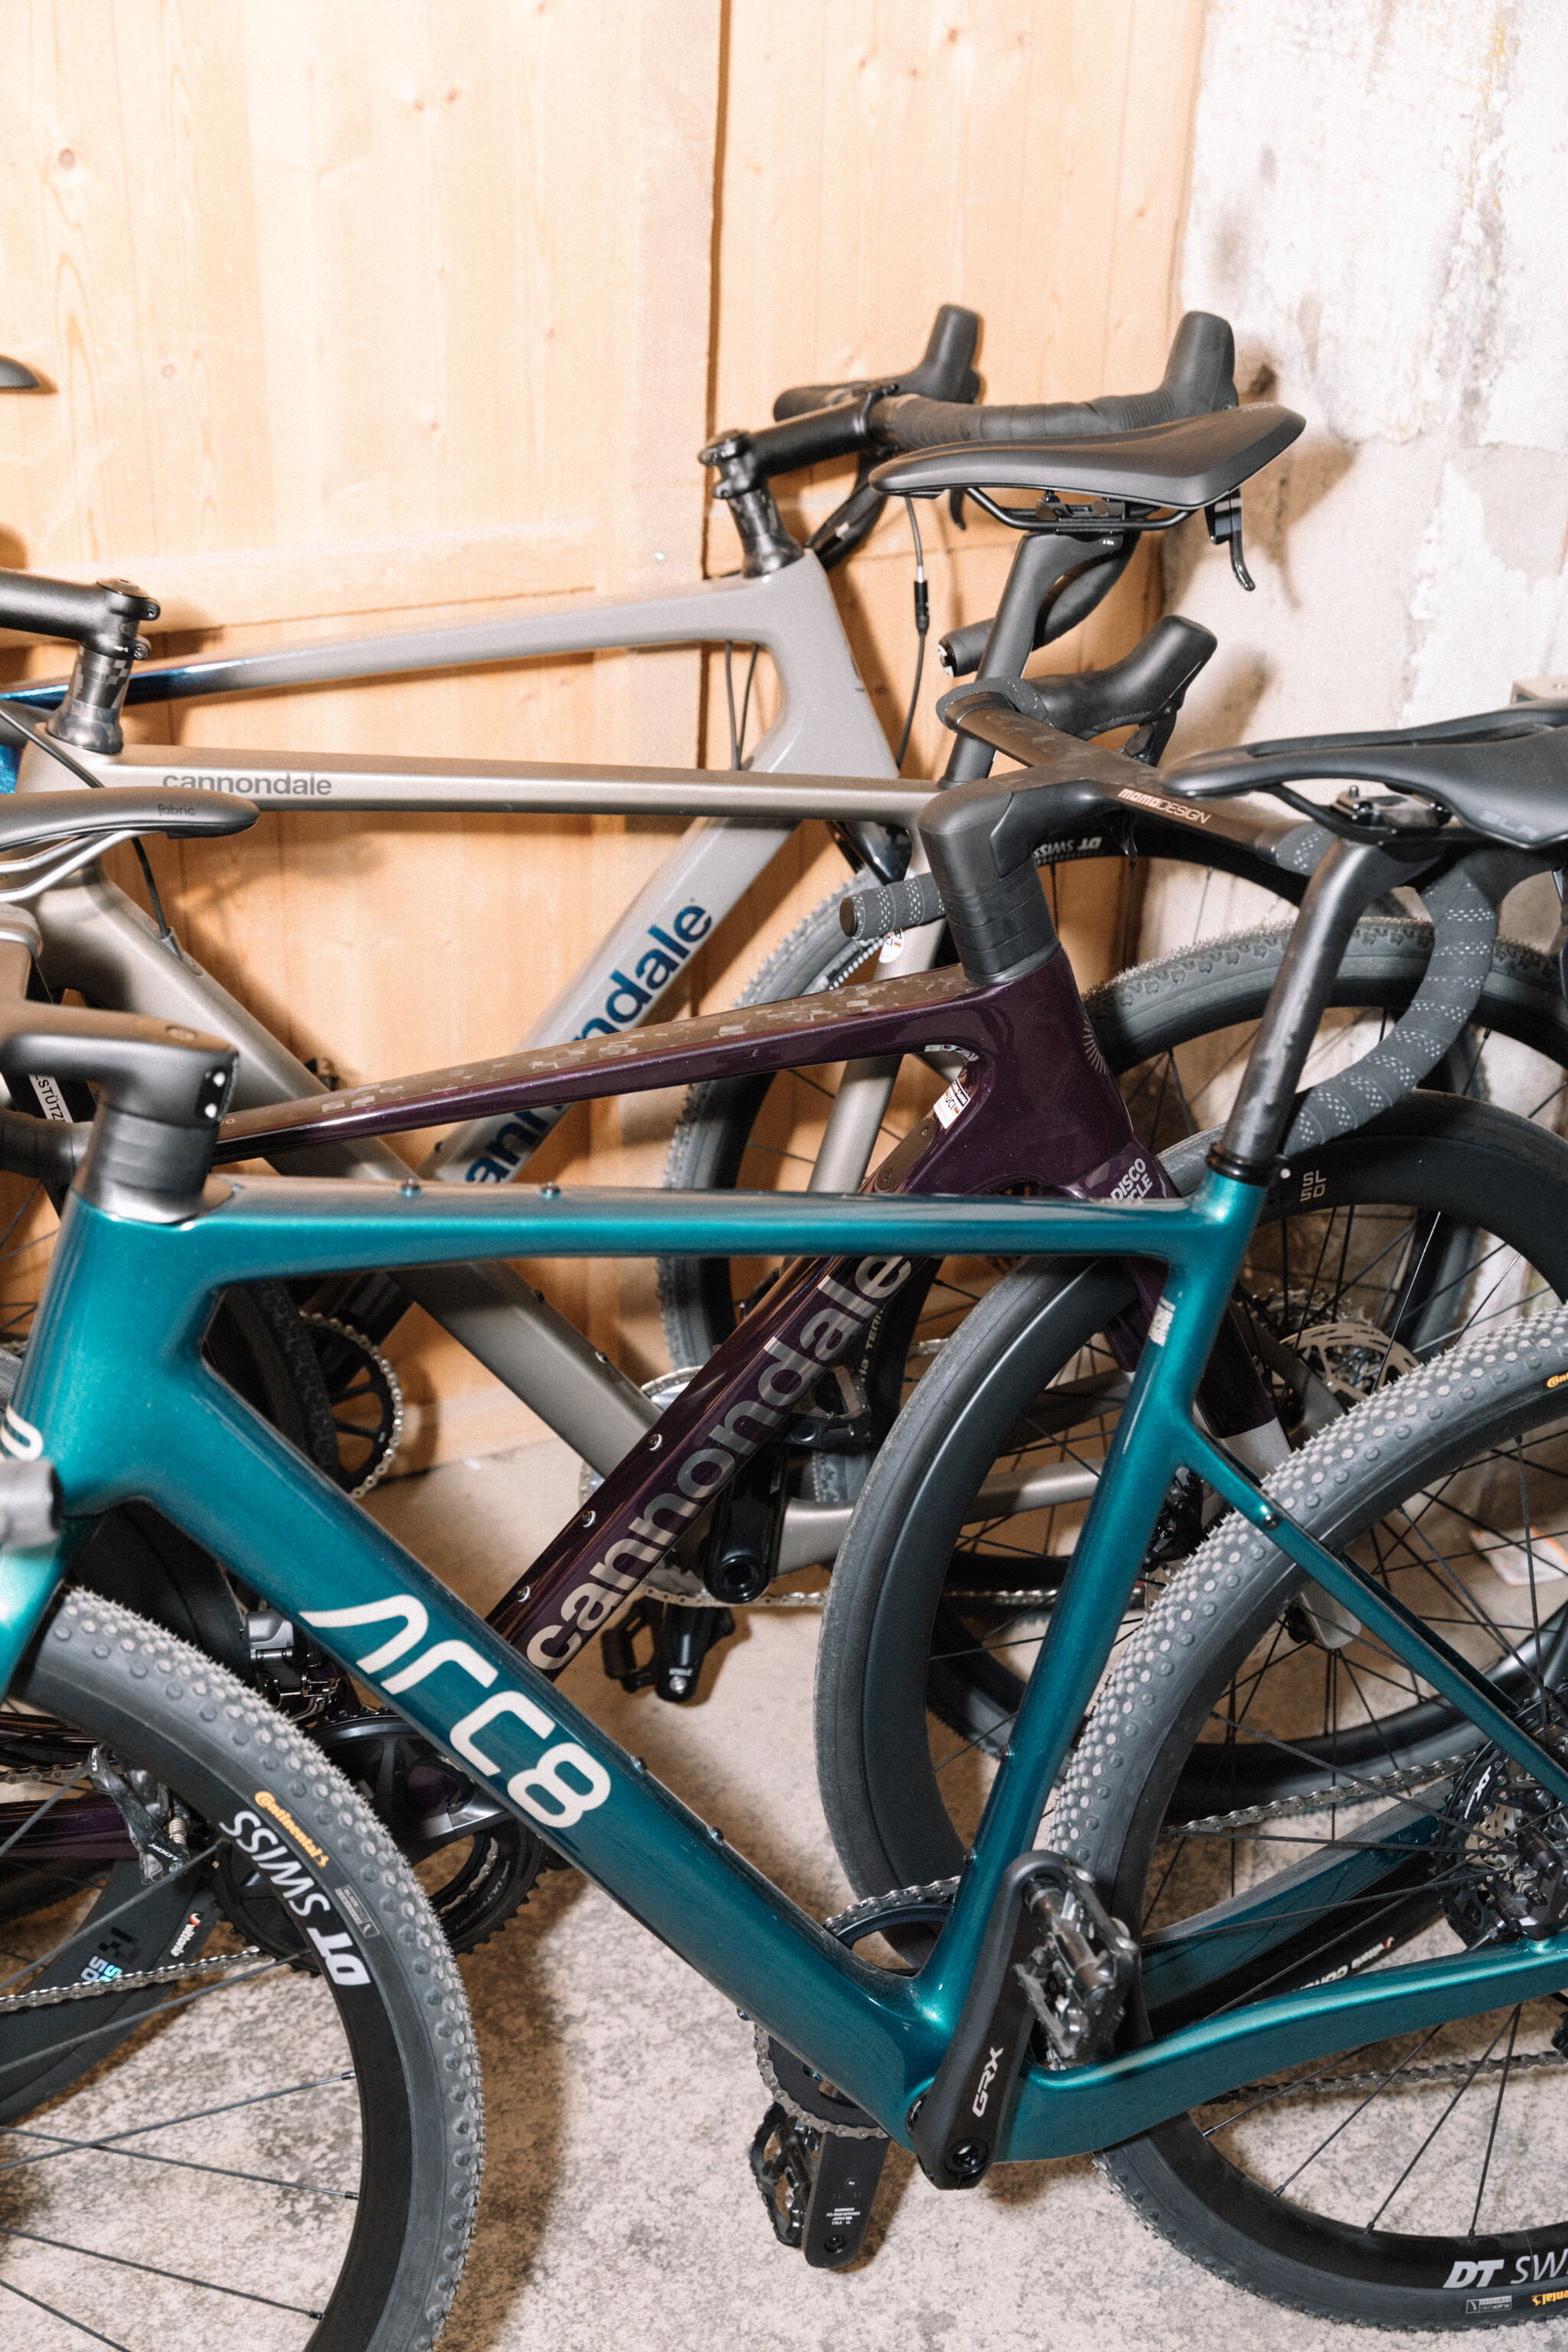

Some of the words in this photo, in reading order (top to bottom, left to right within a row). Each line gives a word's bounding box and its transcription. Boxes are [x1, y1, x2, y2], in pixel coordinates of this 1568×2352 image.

[162, 773, 332, 795] cannondale
[157, 804, 196, 817] fabric
[1076, 835, 1103, 851] DT
[945, 1094, 957, 1110] UCI
[1109, 1158, 1146, 1200] DISCO
[1302, 1169, 1327, 1187] SL
[526, 1256, 911, 1670] cannondale
[1474, 1765, 1491, 1802] XT
[254, 1790, 325, 1860] Continental
[148, 1843, 179, 1861] LOOK
[218, 1810, 332, 1917] SWISS
[305, 1927, 371, 1986] DT
[972, 2046, 1004, 2118] GRX
[1442, 2259, 1505, 2289] DT
